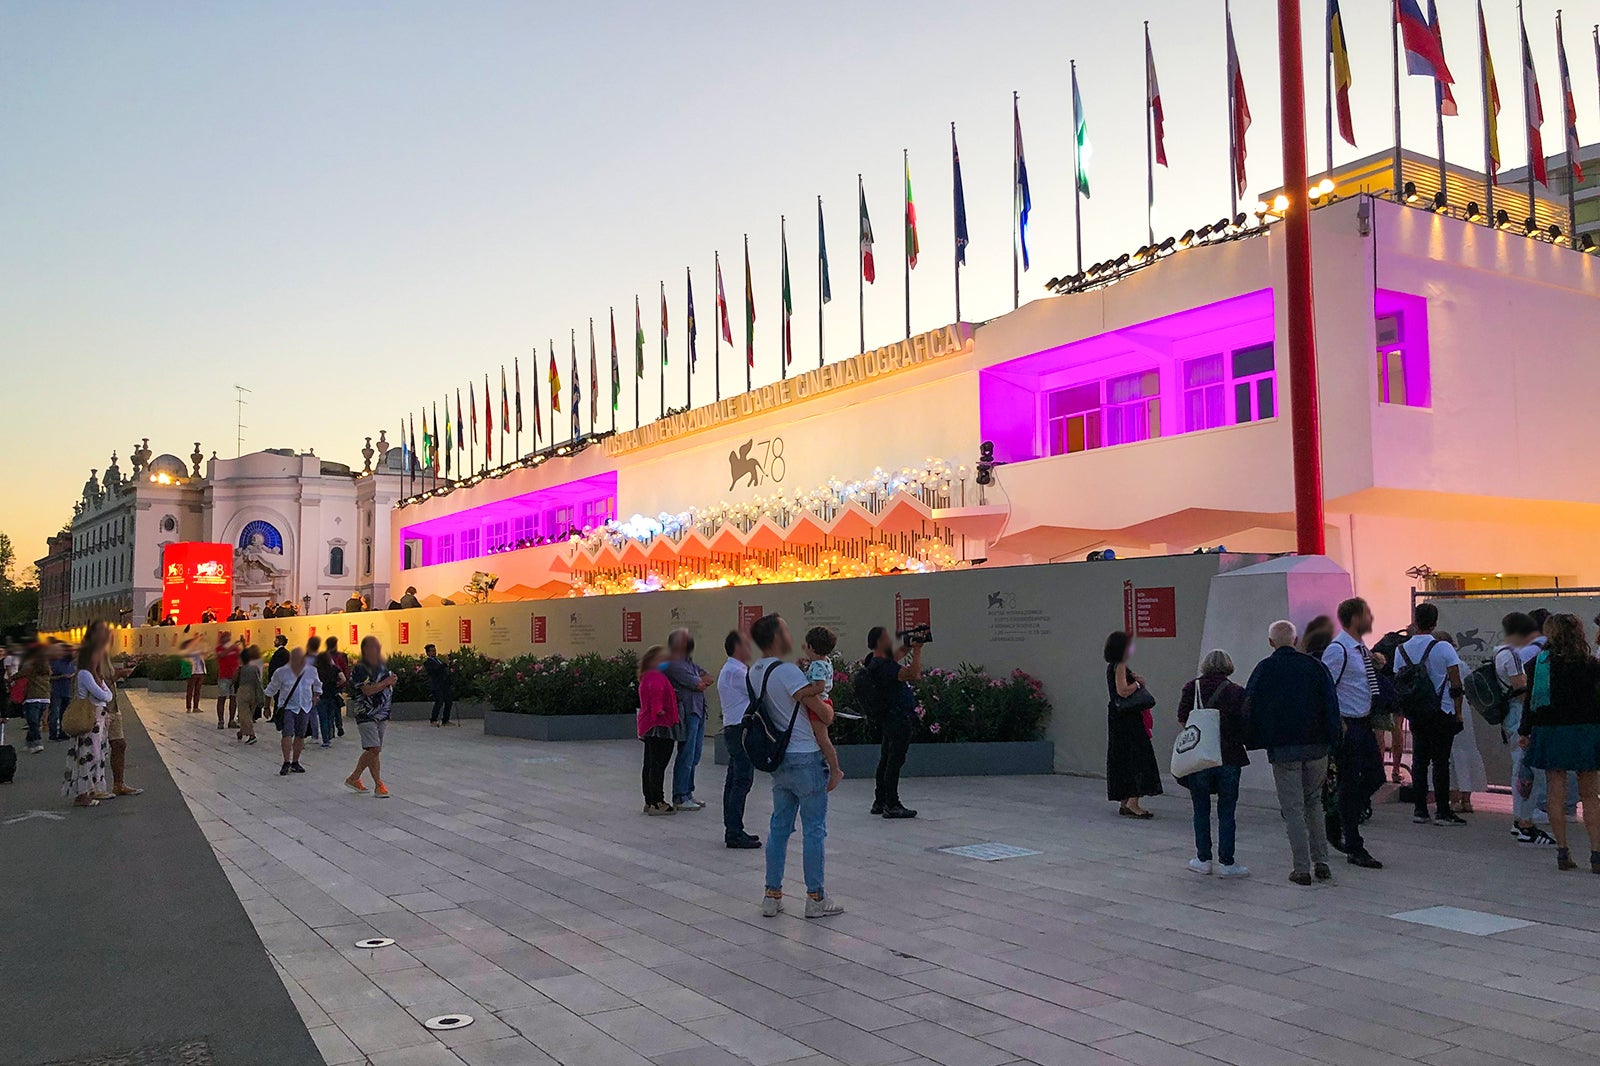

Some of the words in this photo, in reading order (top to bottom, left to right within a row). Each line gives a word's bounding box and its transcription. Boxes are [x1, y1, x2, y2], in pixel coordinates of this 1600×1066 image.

[643, 397, 738, 445] INTERNAZIONALE
[742, 380, 792, 415] D'ARTE
[796, 325, 962, 398] CINEMATOGRAFICA
[757, 437, 785, 486] 78
